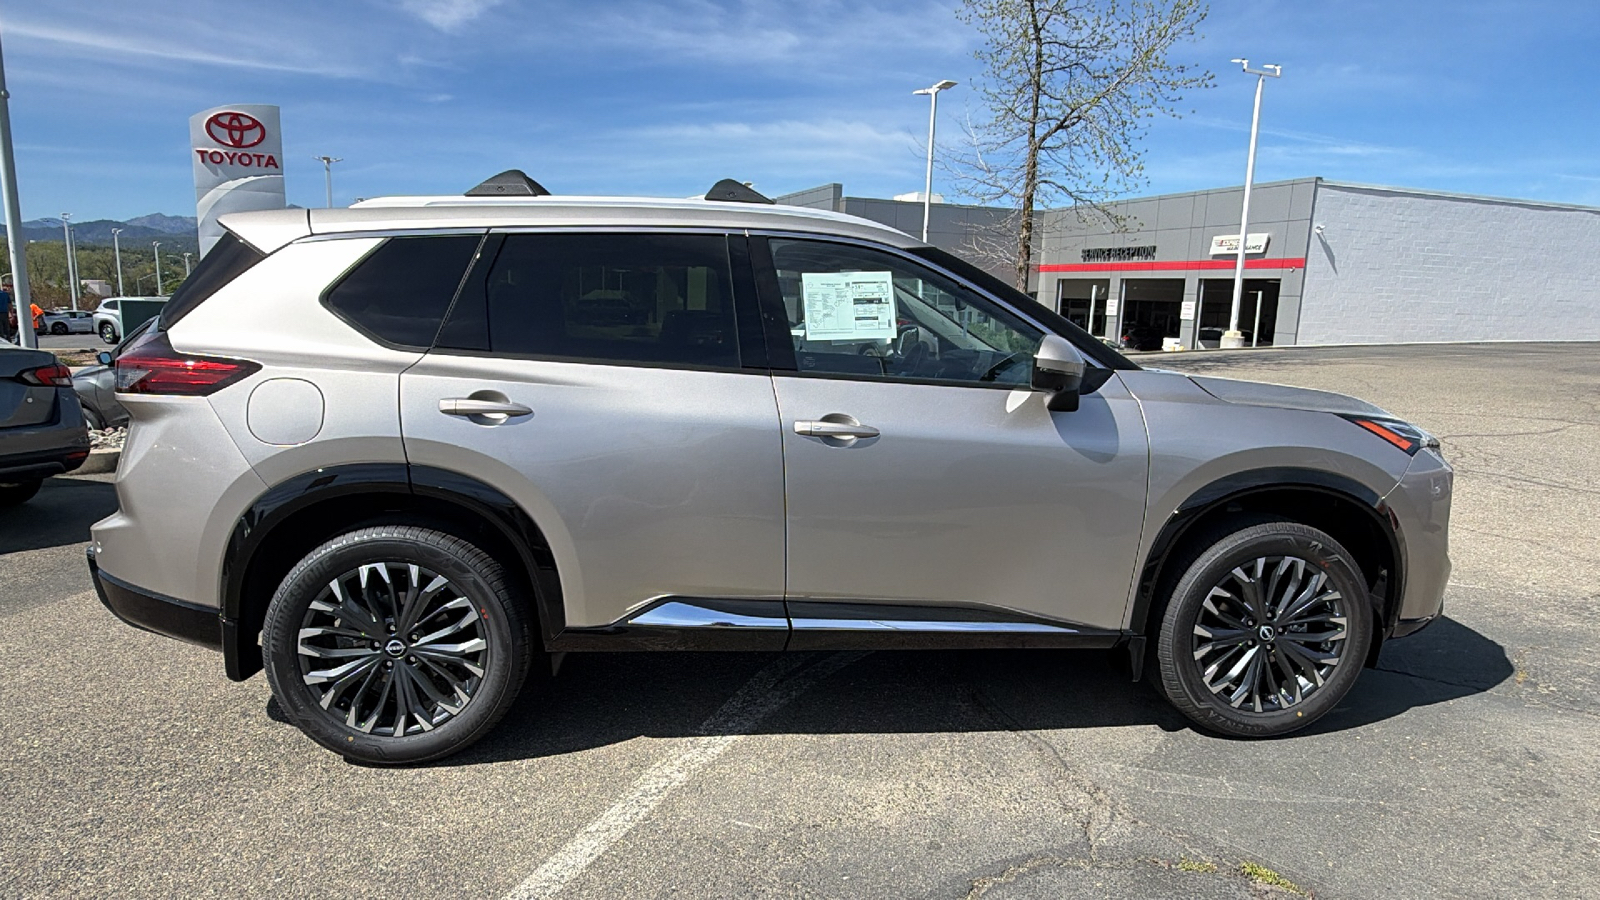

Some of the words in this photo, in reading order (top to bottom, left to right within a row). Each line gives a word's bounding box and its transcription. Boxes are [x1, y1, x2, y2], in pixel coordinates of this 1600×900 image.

[195, 149, 279, 169] TOYOTA
[1081, 247, 1112, 260] SERVICE
[1111, 245, 1157, 259] RECEPTION
